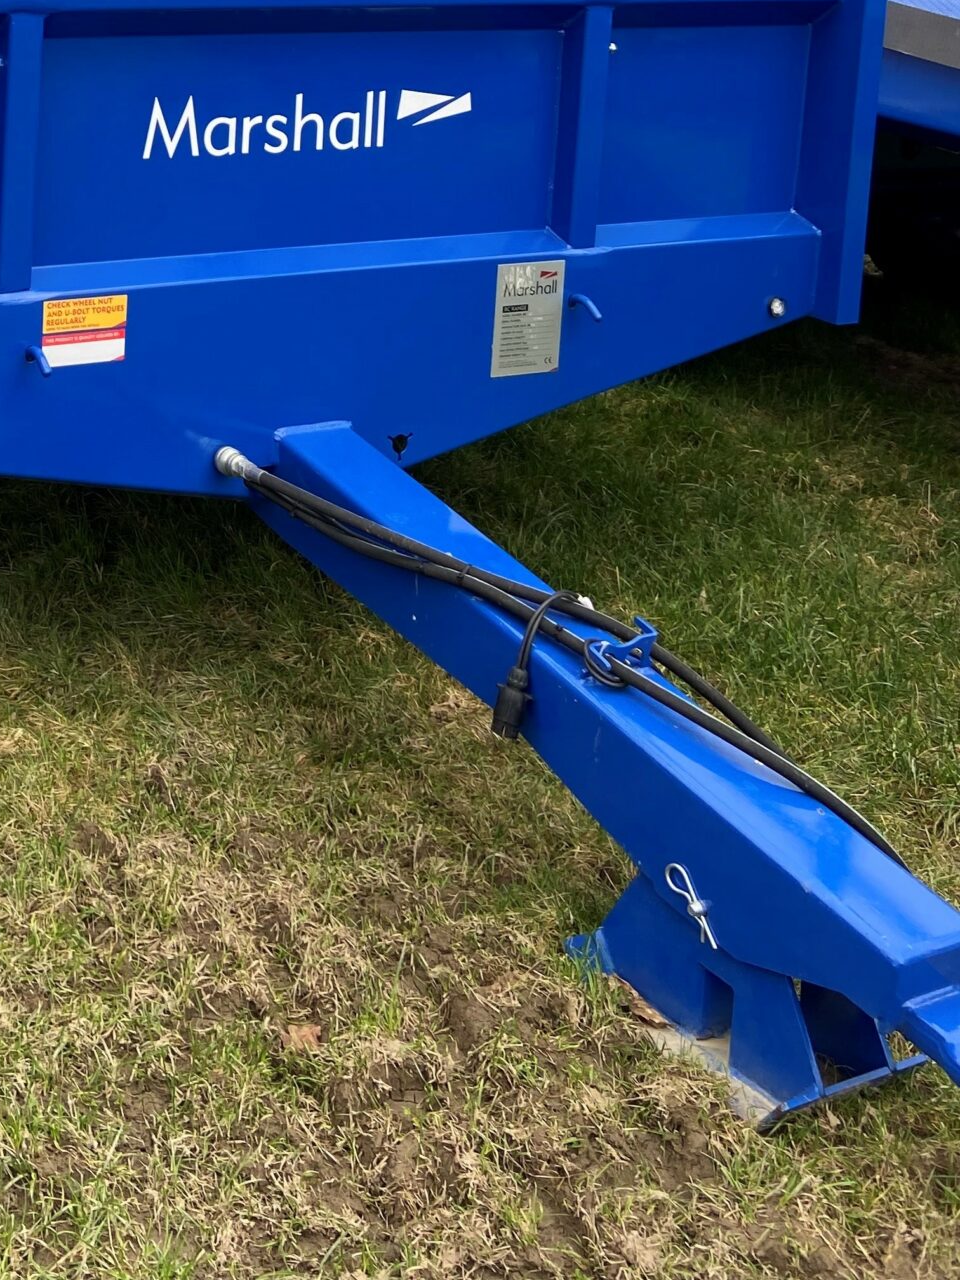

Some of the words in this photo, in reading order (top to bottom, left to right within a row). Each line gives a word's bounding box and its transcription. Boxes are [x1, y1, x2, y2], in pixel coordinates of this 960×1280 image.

[143, 90, 387, 160] Marshall
[503, 279, 558, 298] Marshall
[47, 301, 71, 309] CHECK
[72, 299, 96, 307] WHEEL
[64, 307, 89, 316] U-BOLT
[92, 304, 125, 313] TORQUES
[46, 316, 87, 326] REGULARLY
